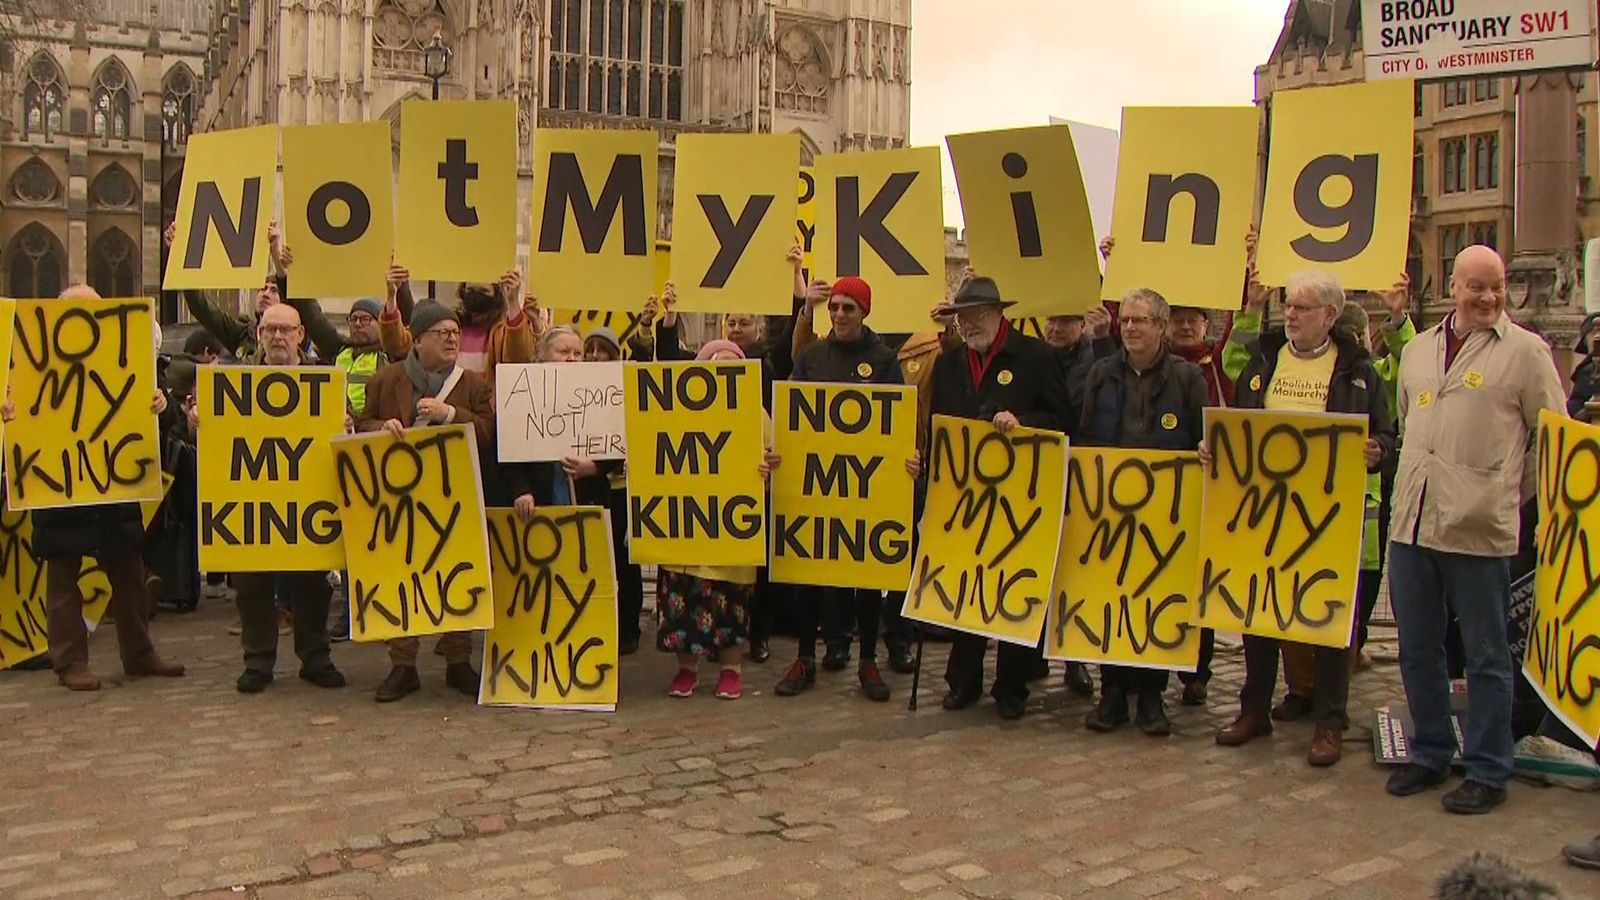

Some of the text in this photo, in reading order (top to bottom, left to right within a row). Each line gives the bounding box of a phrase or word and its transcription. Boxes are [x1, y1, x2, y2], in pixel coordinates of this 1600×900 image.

[1381, 0, 1454, 22] BROAD
[1520, 10, 1569, 34] SW1
[1382, 48, 1534, 74] CITY O WESTMINSTER
[10, 304, 149, 372] NOT
[30, 363, 135, 443] MY
[213, 372, 330, 419] NOT
[505, 368, 557, 418] All
[637, 366, 746, 412] NOT
[789, 388, 902, 435] NOT
[1272, 386, 1327, 401] Monarchy
[1275, 378, 1311, 389] Abolish
[526, 411, 582, 440] NOT
[655, 431, 732, 476] MY
[1210, 419, 1364, 494] NOT
[14, 433, 154, 498] KING
[230, 437, 313, 481] MY
[336, 432, 463, 508] NOT
[802, 453, 884, 499] MY
[934, 425, 1060, 500] NOT
[1065, 454, 1200, 524] NOT
[202, 501, 341, 546] KING
[367, 494, 460, 574] MY
[486, 511, 601, 576] NOT
[631, 495, 762, 539] KING
[775, 514, 909, 564] KING
[945, 486, 1041, 569] MY
[1227, 480, 1340, 571] MY
[1079, 514, 1186, 599] MY
[1540, 510, 1600, 626] MY
[355, 563, 485, 633] KING
[507, 566, 596, 645] MY
[914, 555, 1041, 624] KING
[1199, 558, 1346, 631] KING
[1056, 591, 1196, 655] KING
[491, 638, 613, 698] KING
[1527, 608, 1600, 706] KING
